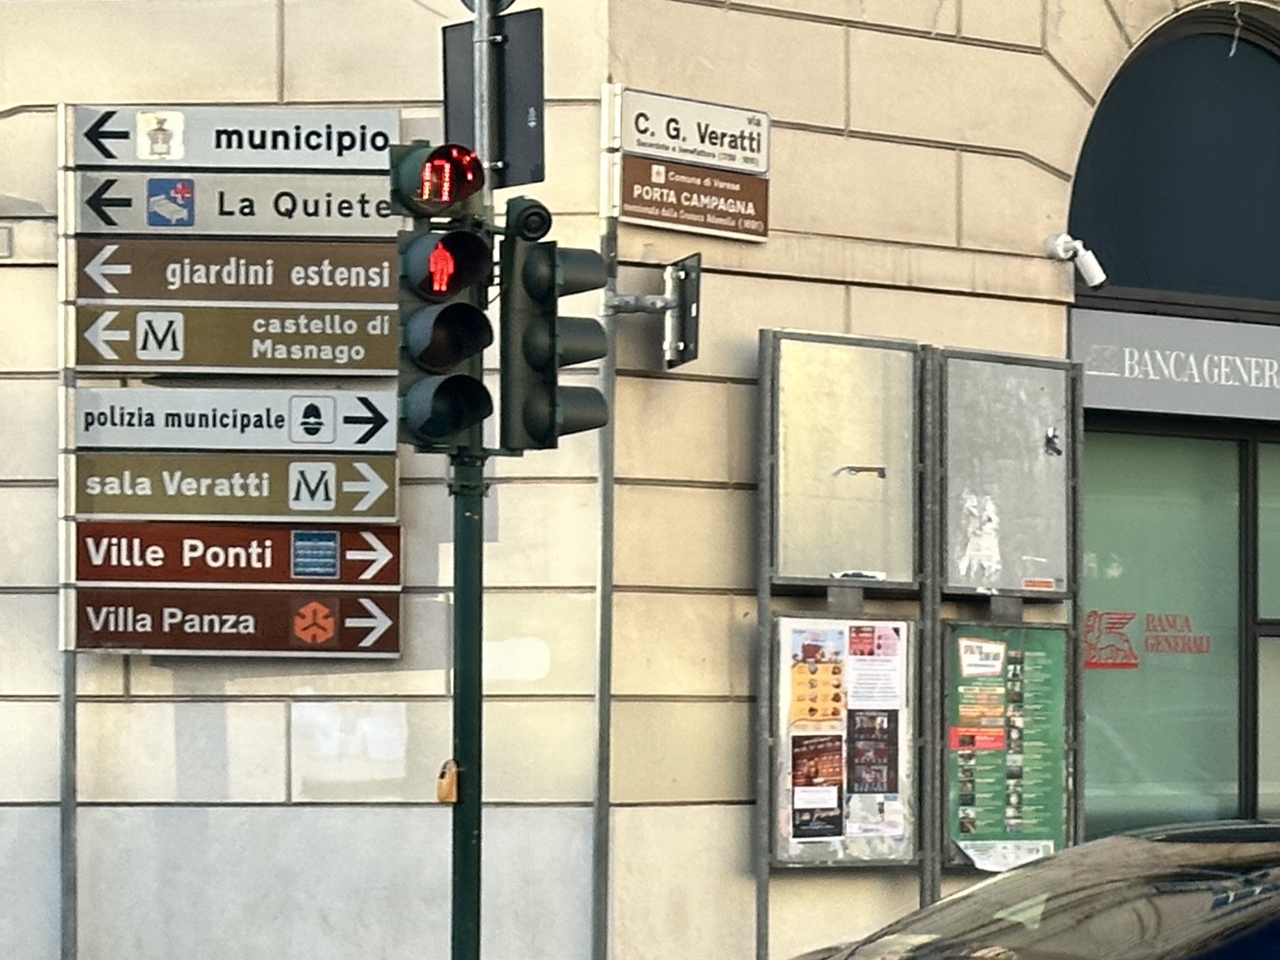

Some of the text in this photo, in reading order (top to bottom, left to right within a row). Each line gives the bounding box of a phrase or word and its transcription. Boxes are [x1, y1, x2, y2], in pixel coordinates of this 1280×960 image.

[634, 112, 762, 154] C. G. Veratti
[746, 115, 762, 127] via
[214, 124, 390, 157] municipio
[703, 176, 713, 187] di
[217, 190, 392, 219] La Quiete
[633, 184, 757, 216] PORTA CAMPAGNA
[165, 256, 391, 290] giardini estensi
[139, 319, 180, 352] M
[252, 314, 390, 335] castello di
[252, 338, 366, 364] Masnago
[1123, 346, 1201, 383] BANCA
[83, 405, 286, 434] polizia municipale
[85, 470, 271, 498] sala Veratti
[291, 469, 333, 502] M
[84, 536, 274, 569] Ville Ponti
[85, 605, 256, 634] Villa Panza
[1144, 612, 1193, 633] BANCA
